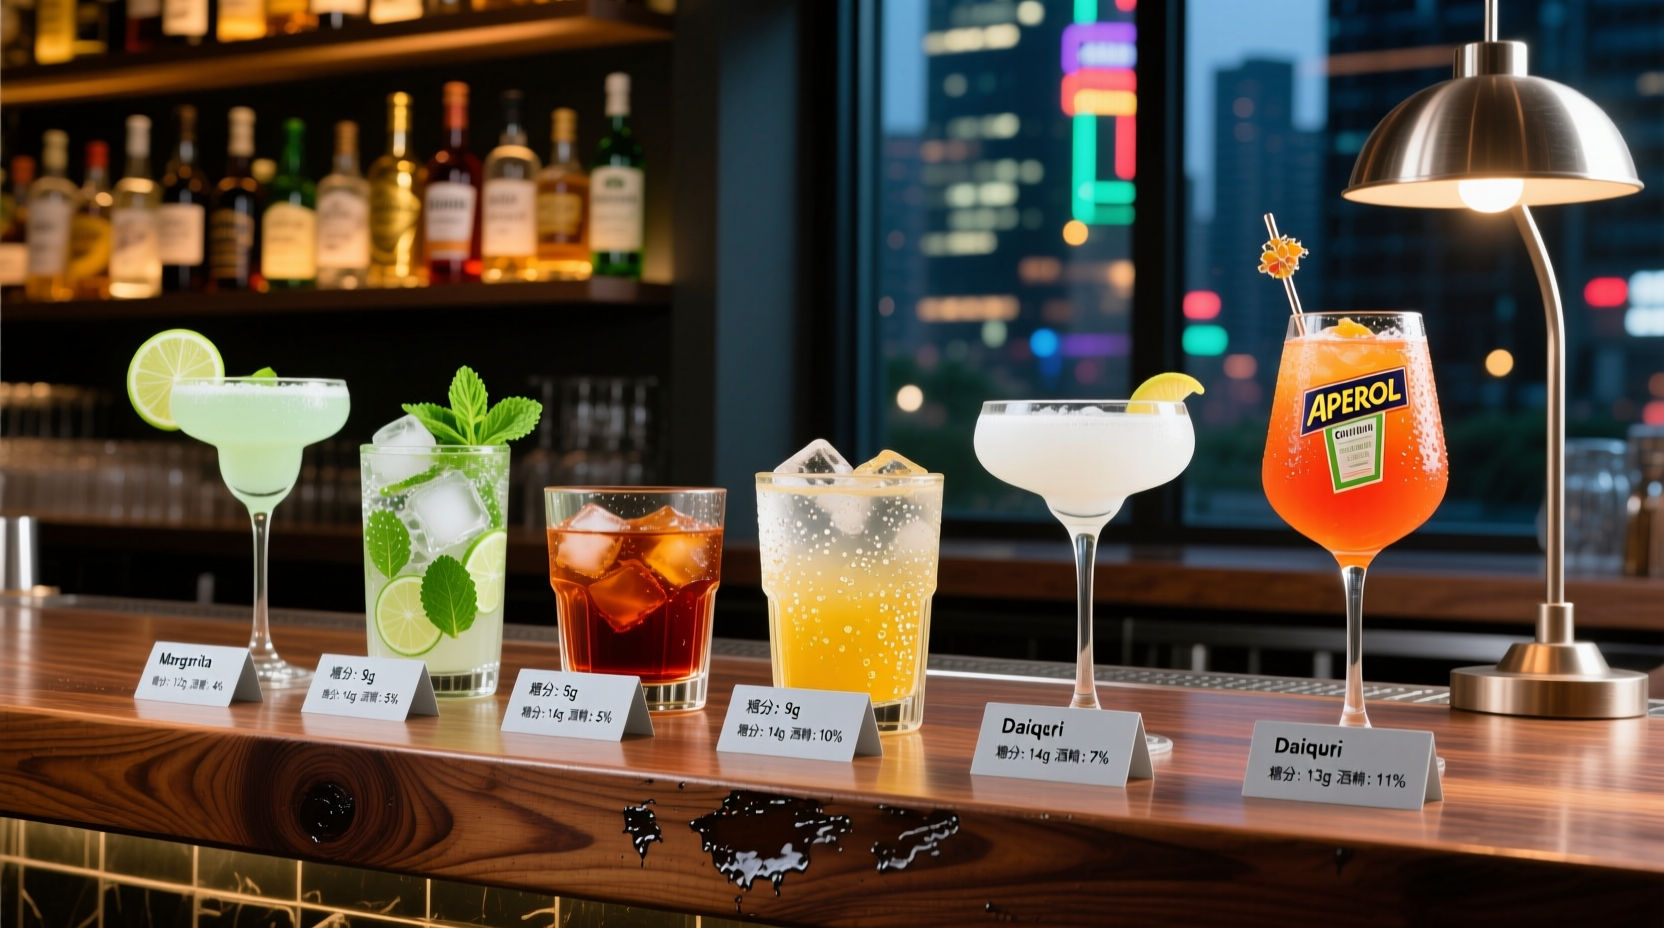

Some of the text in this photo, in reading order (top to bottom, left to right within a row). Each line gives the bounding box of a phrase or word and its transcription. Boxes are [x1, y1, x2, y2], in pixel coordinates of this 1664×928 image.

[1307, 378, 1401, 427] APEROL
[361, 669, 375, 685] 9g
[563, 685, 578, 701] 5g
[596, 710, 612, 723] 5%
[785, 702, 800, 720] 9g
[820, 729, 842, 743] 10%
[1030, 748, 1050, 764] 14g
[1090, 750, 1109, 764] 7%
[1275, 737, 1343, 760] Daiquri
[1308, 769, 1331, 787] 13g
[1377, 773, 1406, 788] 11%
